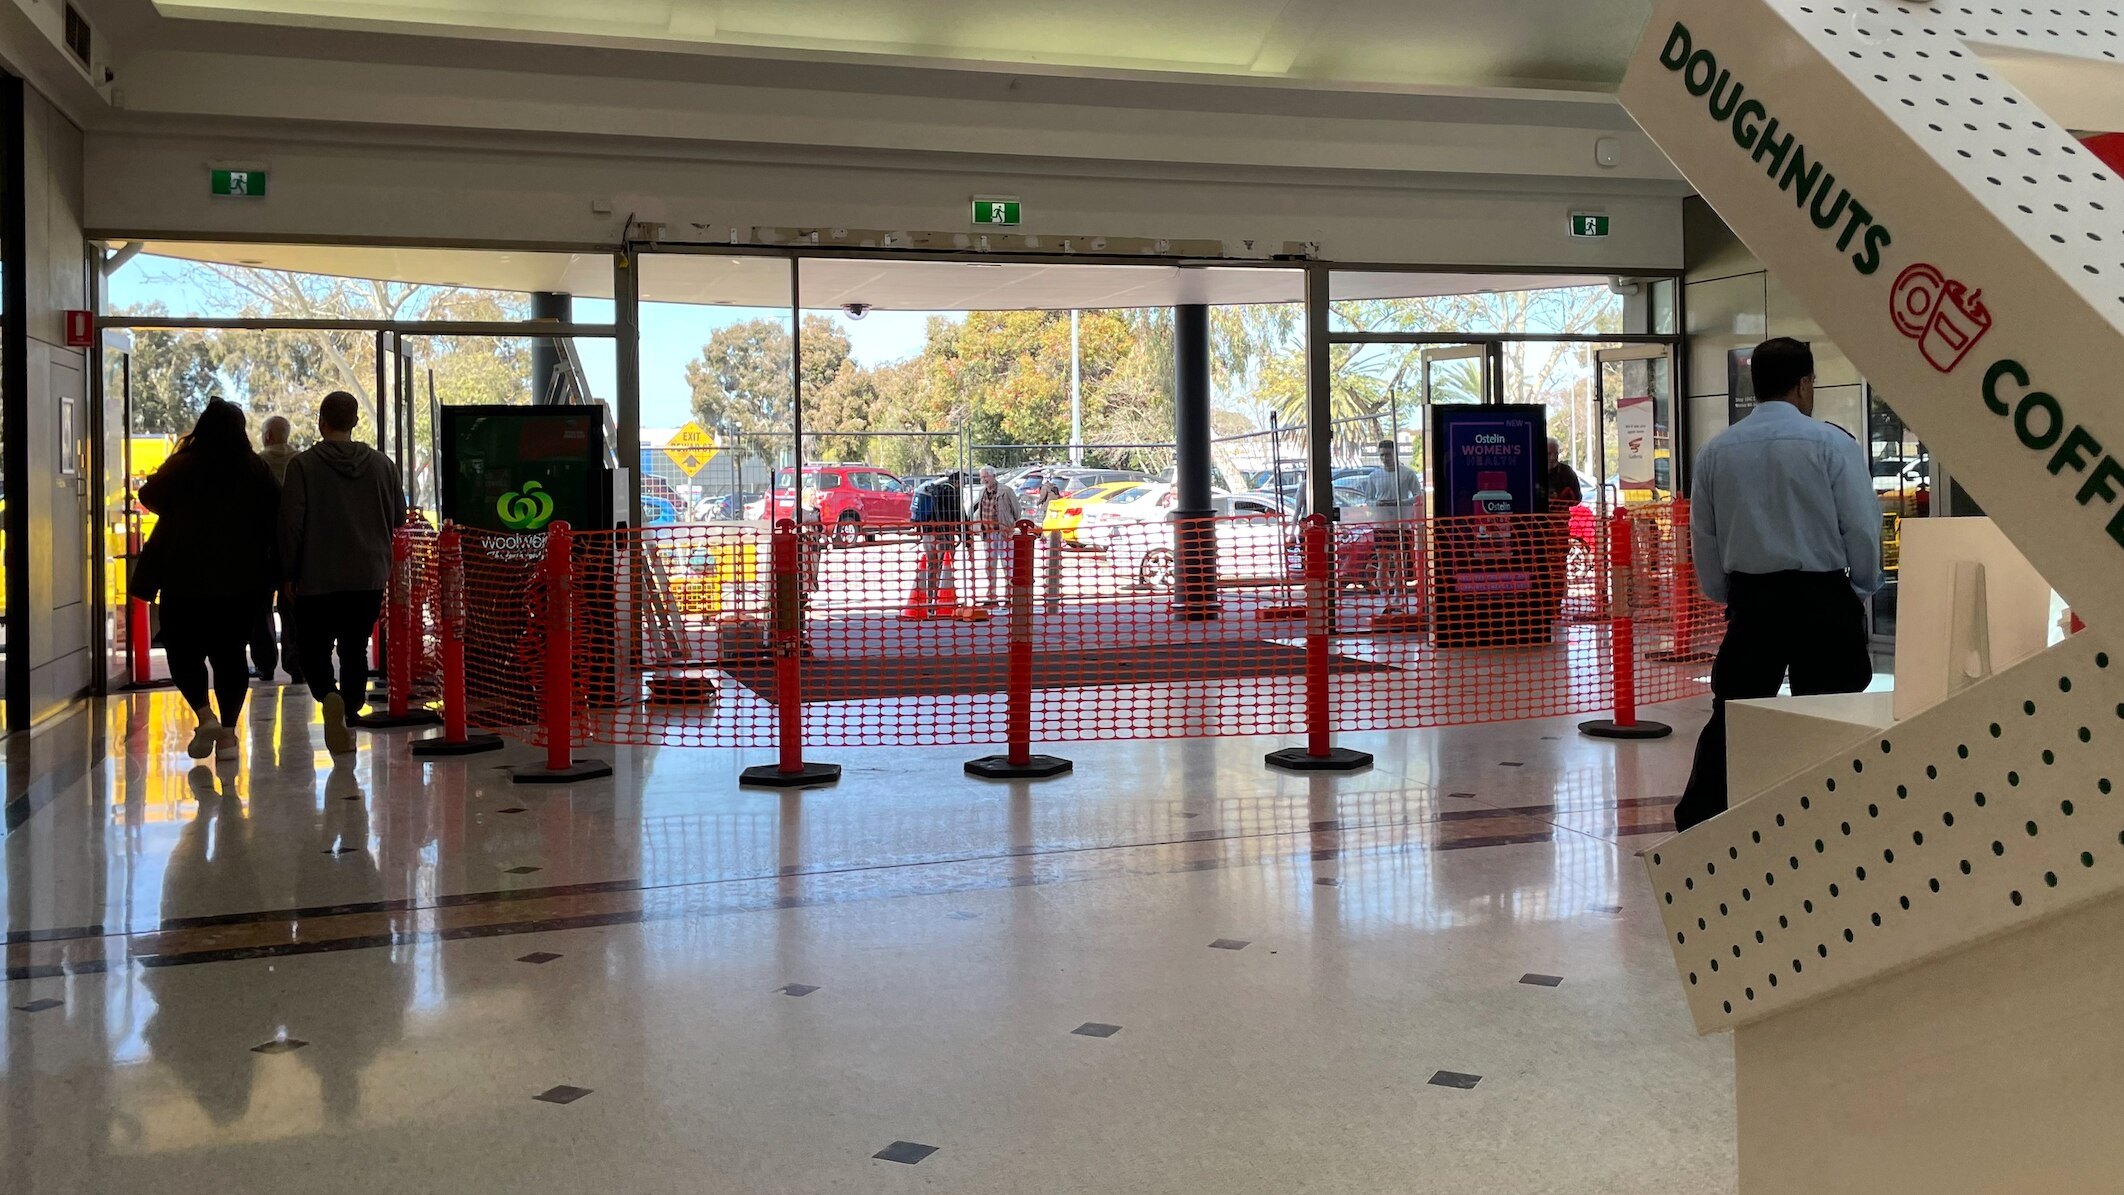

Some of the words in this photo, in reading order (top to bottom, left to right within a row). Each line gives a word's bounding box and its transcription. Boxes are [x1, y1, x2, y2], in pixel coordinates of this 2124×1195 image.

[1660, 21, 1891, 275] DOUGHNUTS
[1505, 419, 1523, 427] NEW
[682, 431, 701, 441] EXIT
[1475, 433, 1505, 443] Ostelin
[1461, 444, 1521, 456] WOMEN'S
[1466, 456, 1517, 466] HEALTH
[1487, 501, 1511, 512] Ostelin
